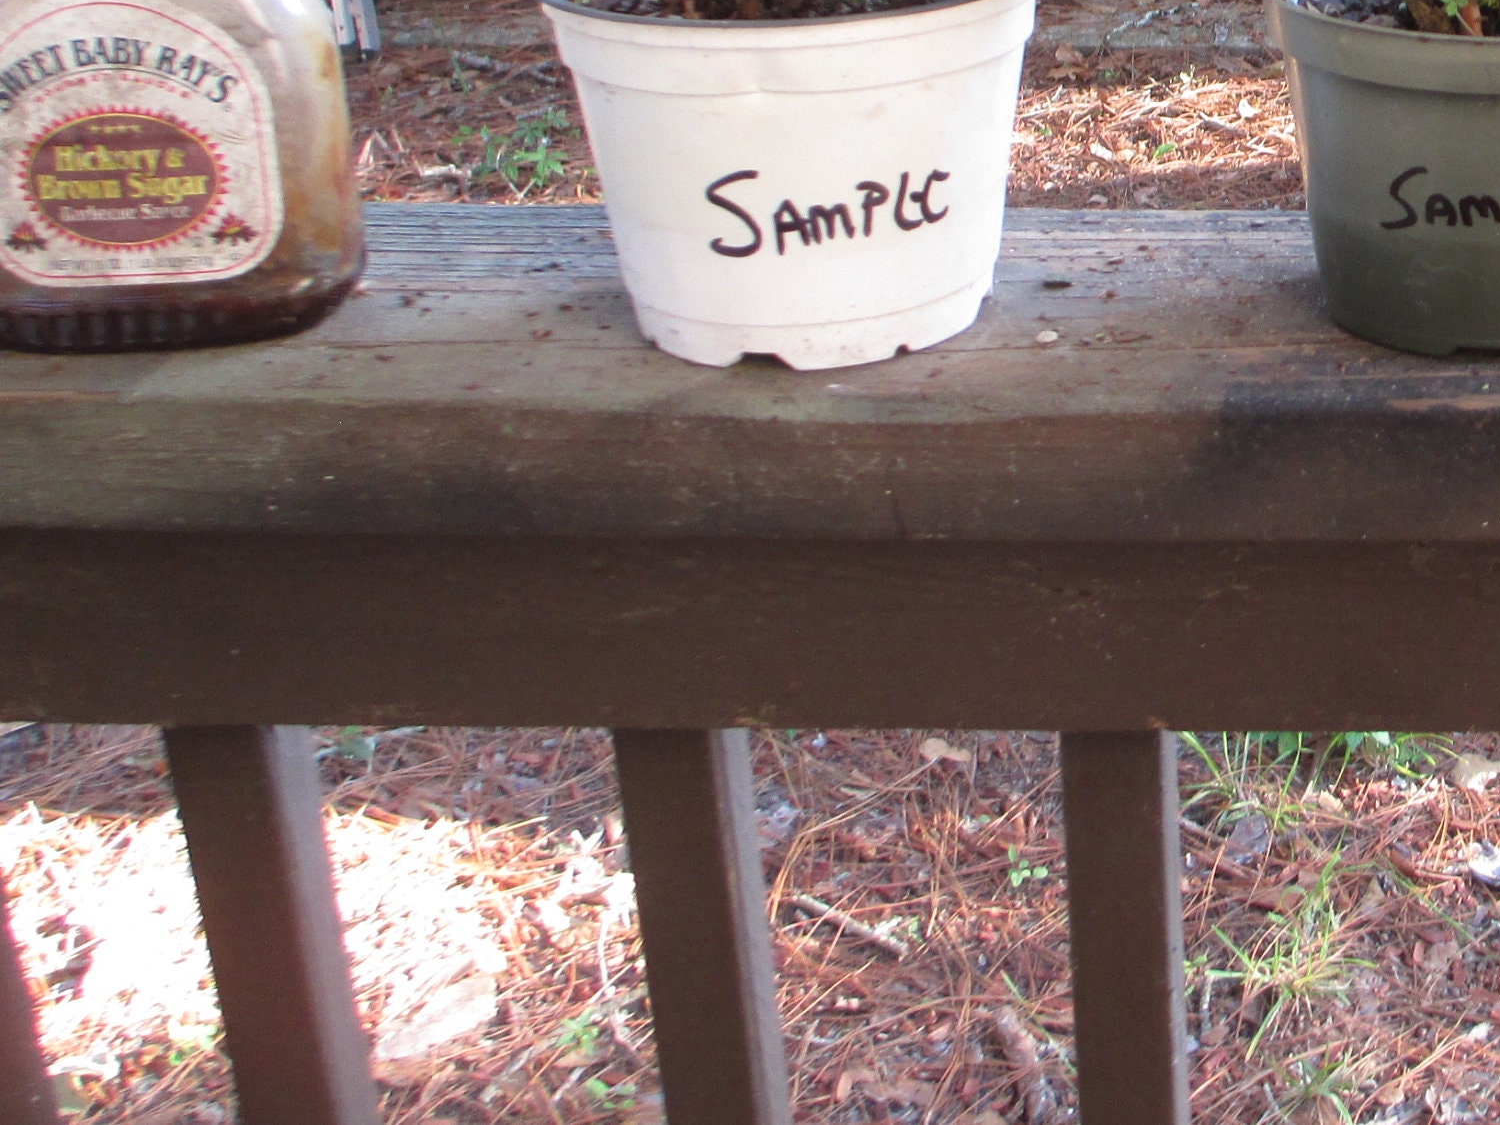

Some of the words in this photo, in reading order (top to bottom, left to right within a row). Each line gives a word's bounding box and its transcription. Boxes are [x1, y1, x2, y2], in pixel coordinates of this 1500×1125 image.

[69, 36, 151, 67] BABY
[157, 45, 238, 103] RAY'S
[126, 173, 210, 205] Sugar
[705, 169, 950, 258] SAMPLE
